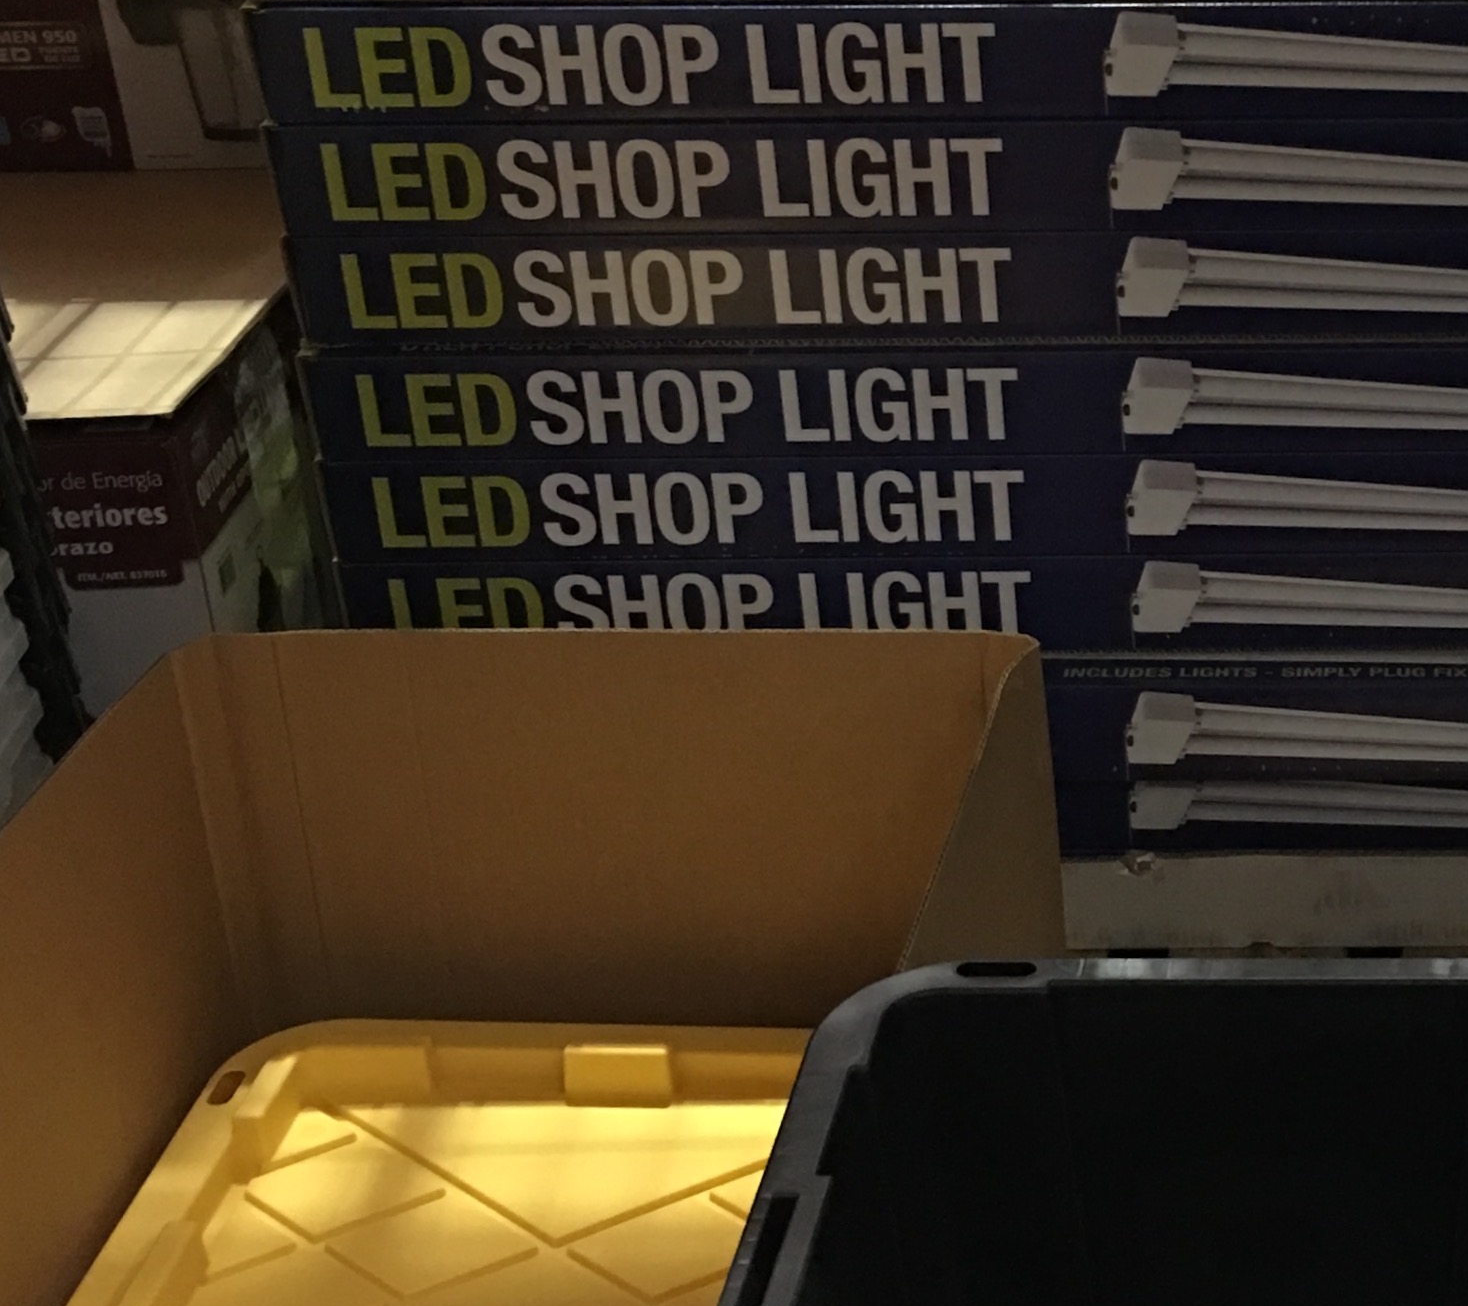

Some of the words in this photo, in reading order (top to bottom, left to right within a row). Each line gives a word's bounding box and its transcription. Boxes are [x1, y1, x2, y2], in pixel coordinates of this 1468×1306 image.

[302, 27, 472, 109] LED
[480, 23, 720, 108] SHOP
[743, 21, 996, 106] LIGHT
[320, 141, 487, 222] LED
[495, 139, 730, 221] SHOP
[754, 138, 1003, 219] LIGHT
[340, 251, 504, 330] LED
[512, 248, 743, 328] SHOP
[768, 246, 1012, 326] LIGHT
[353, 372, 517, 449] LED
[526, 369, 754, 447] SHOP
[778, 367, 1019, 444] LIGHT
[48, 503, 168, 529] teriores
[61, 472, 86, 490] de
[373, 475, 531, 550] LED
[539, 471, 763, 547] SHOP
[787, 469, 1025, 543] LIGHT
[387, 577, 545, 630] LED
[553, 573, 774, 631] SHOP
[796, 570, 1032, 635] LIGHT
[1062, 667, 1173, 679] INCLUDES
[1178, 667, 1258, 679] LIGHTS
[1281, 667, 1363, 679] SIMPLY
[1368, 667, 1426, 679] PLUG
